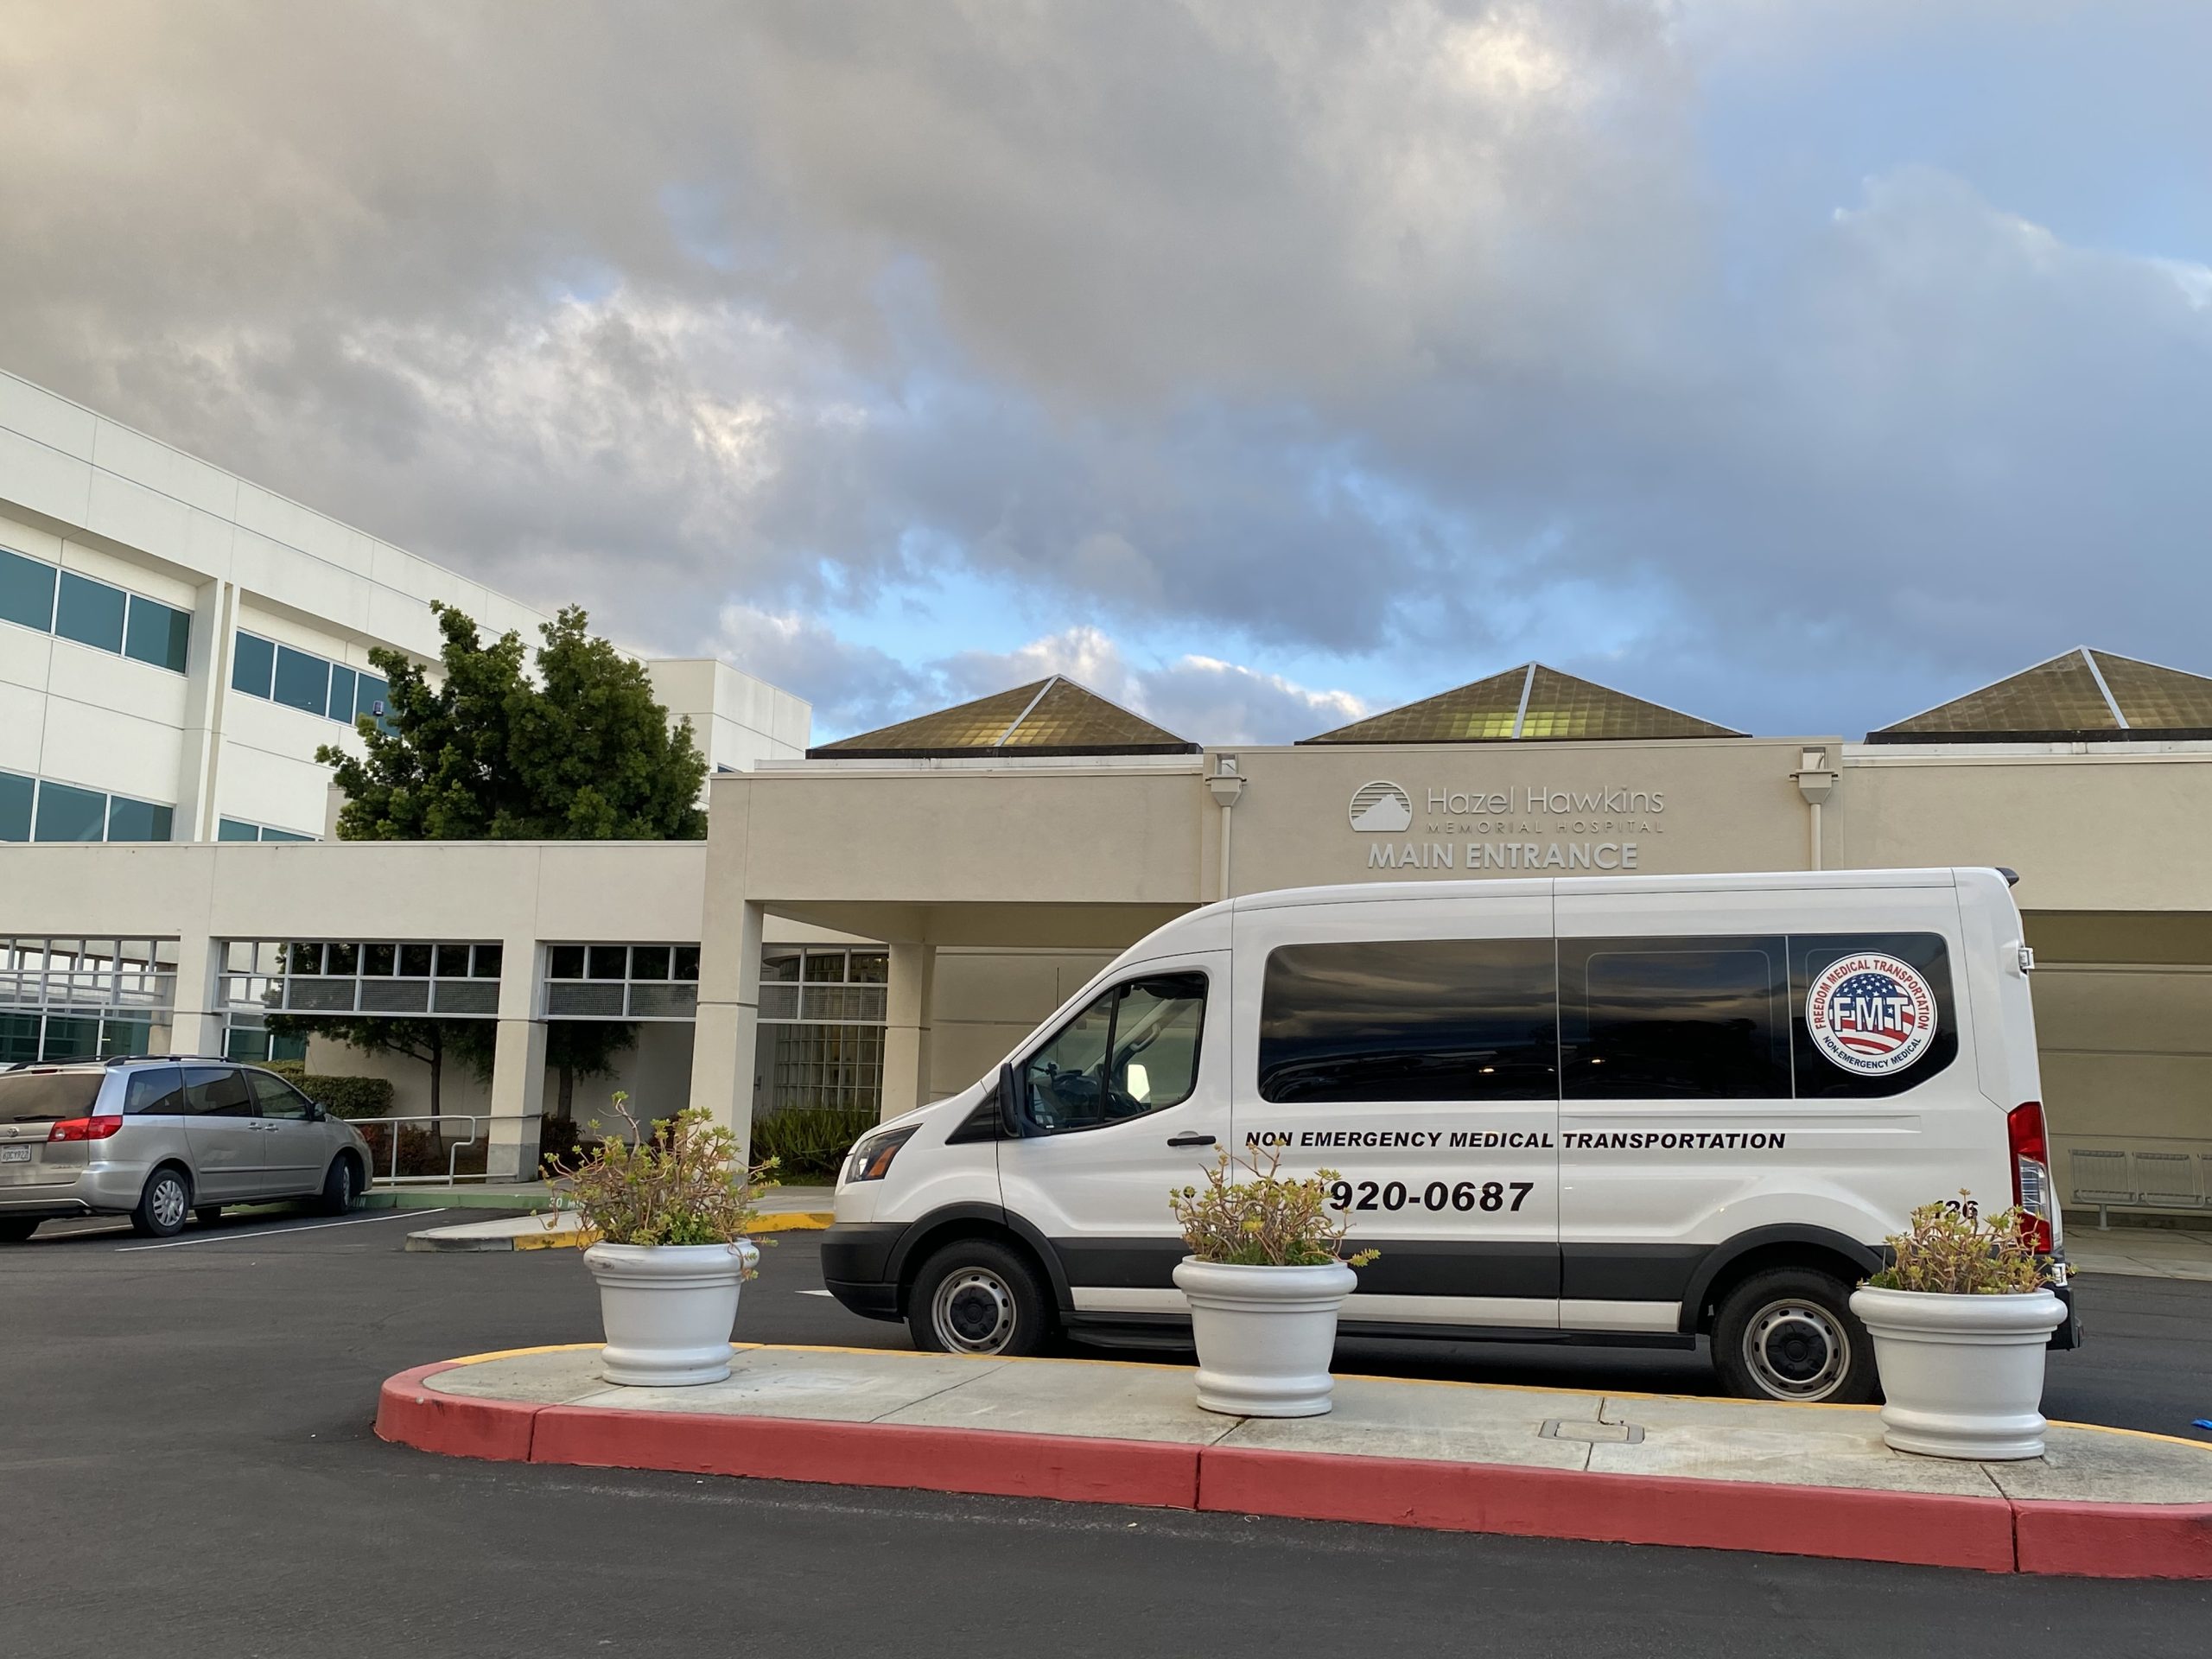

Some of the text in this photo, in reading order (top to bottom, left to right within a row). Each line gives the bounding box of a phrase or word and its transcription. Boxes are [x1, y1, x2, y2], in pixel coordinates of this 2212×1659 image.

[1427, 785, 1664, 815] Hazel Hawkins
[1426, 820, 1663, 835] MEMORIAL HOSPITAL
[1367, 842, 1638, 870] MAIN ENTRANCE
[1813, 959, 1930, 1031] FREEDOM MEDICAL TRANSPORTATION
[1832, 995, 1910, 1033] FMT
[1822, 1035, 1923, 1069] NON-EMERGENCY MEDICAL
[1245, 1131, 1786, 1149] NON EMERGENCY MEDICAL TRANSPORTATION
